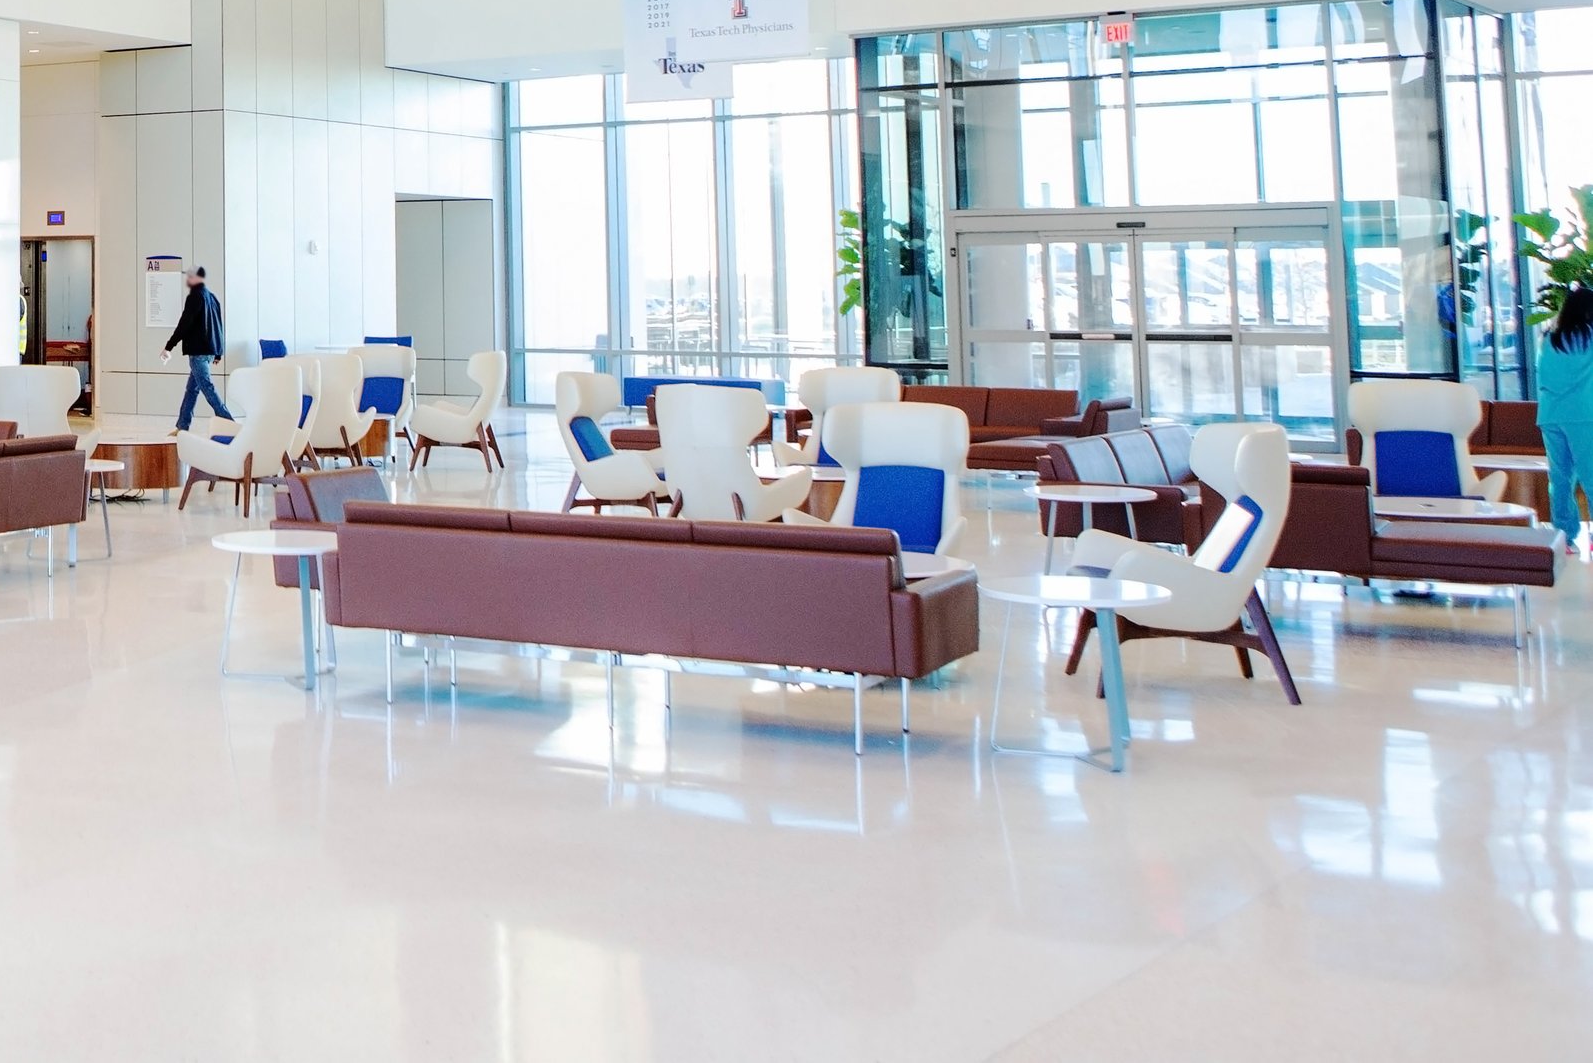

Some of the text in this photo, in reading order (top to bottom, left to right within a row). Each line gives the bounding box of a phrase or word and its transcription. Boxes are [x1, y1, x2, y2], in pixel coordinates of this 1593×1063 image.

[689, 22, 794, 38] Texas Tech Physicians
[1106, 24, 1128, 42] EXIT
[658, 58, 705, 75] Texas
